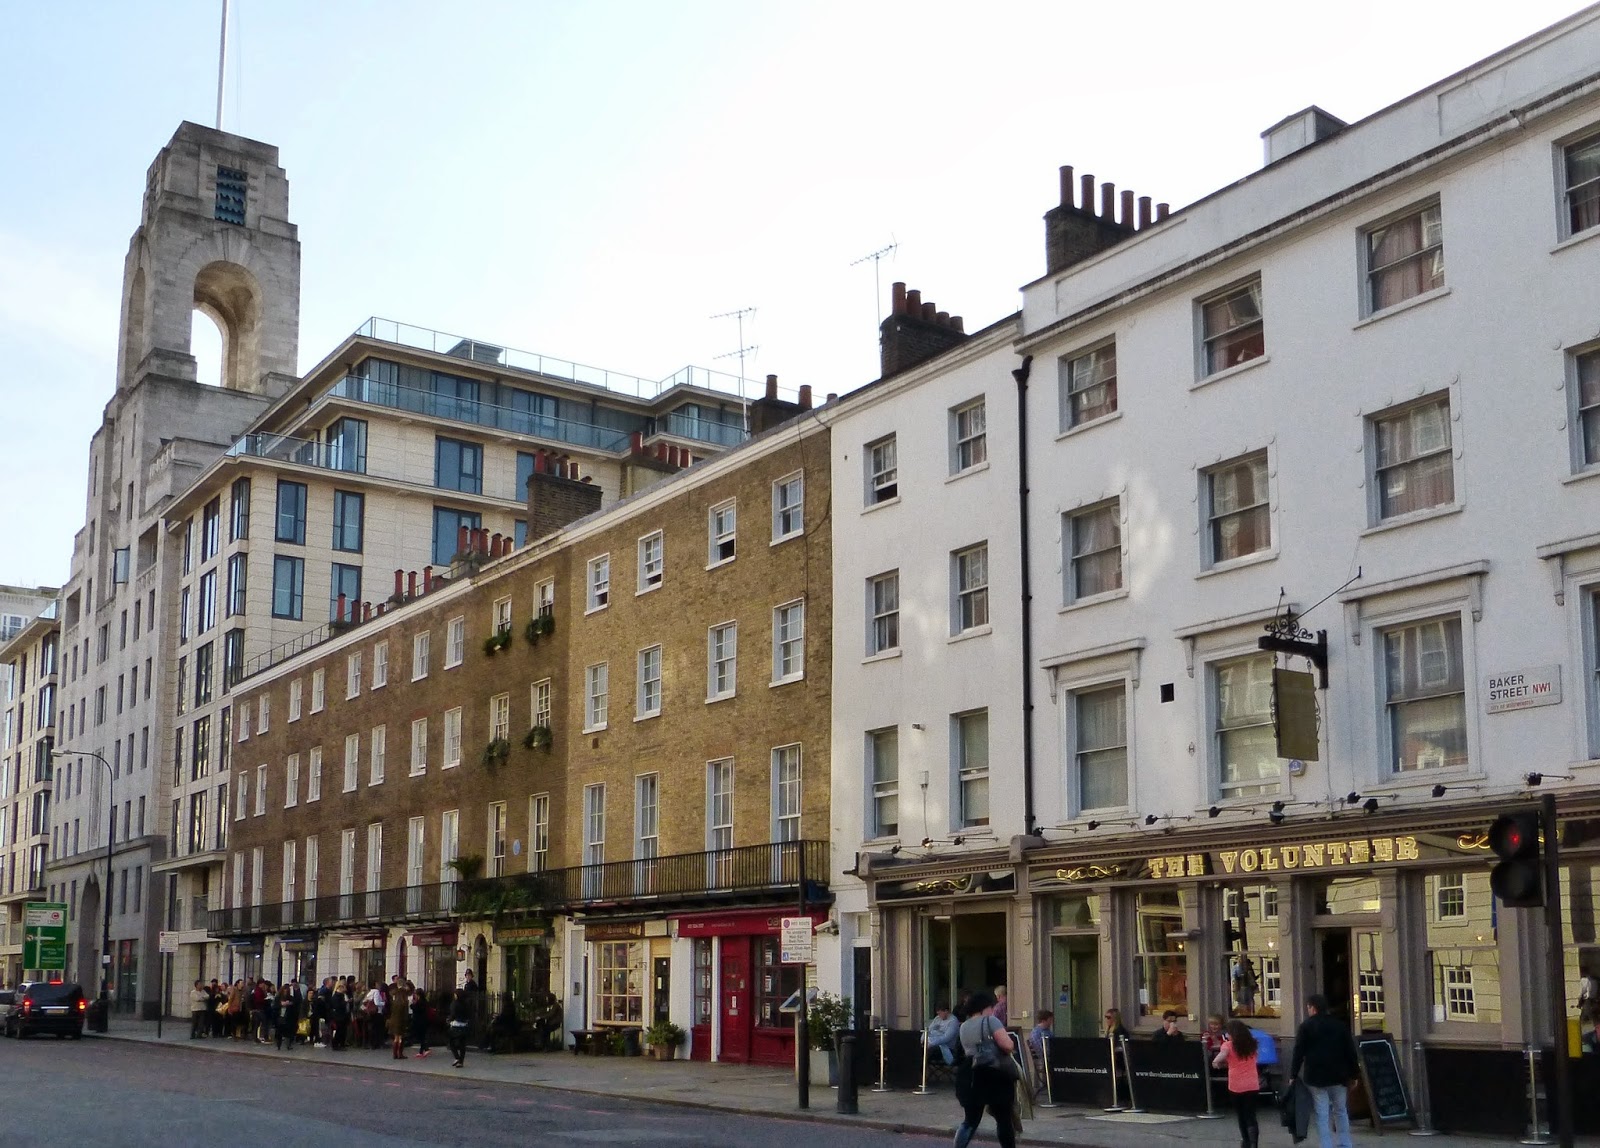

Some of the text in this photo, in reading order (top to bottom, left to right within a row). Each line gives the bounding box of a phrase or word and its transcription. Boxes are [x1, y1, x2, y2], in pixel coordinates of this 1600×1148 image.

[1489, 674, 1524, 689] BAKER
[1490, 682, 1551, 700] STREET NW1
[1148, 836, 1419, 879] THE VOLUNTEER
